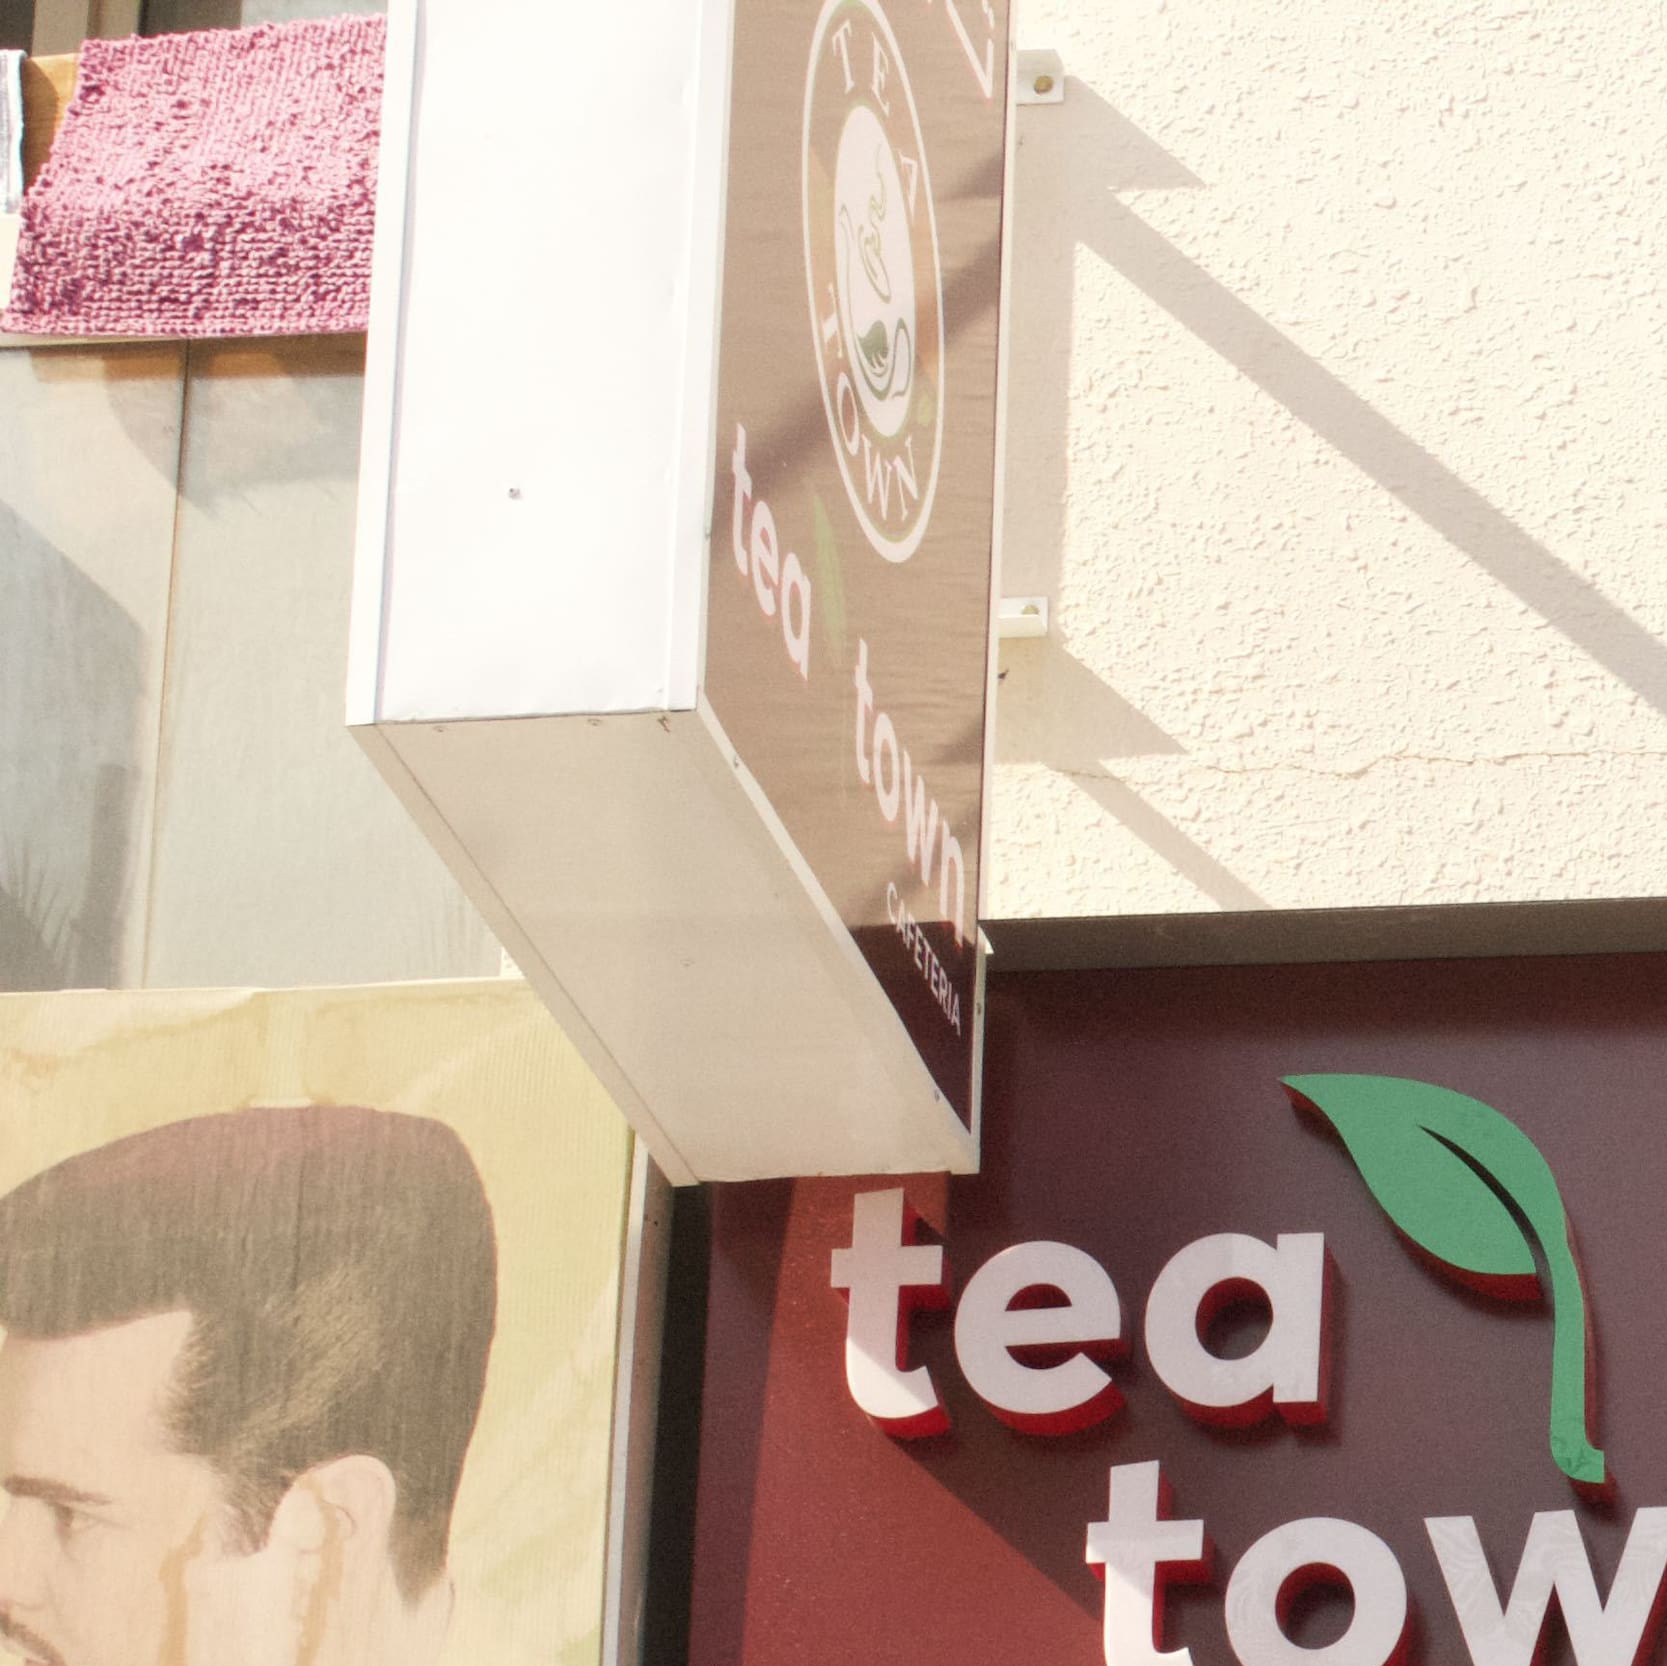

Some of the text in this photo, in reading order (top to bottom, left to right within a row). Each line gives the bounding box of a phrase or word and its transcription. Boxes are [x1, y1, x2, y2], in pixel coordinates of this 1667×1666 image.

[831, 19, 918, 214] TEA
[823, 283, 919, 522] TOWN
[732, 422, 812, 681] tea
[854, 637, 964, 949] town
[886, 881, 962, 1038] CAFETERIA
[830, 1187, 1328, 1425] tea
